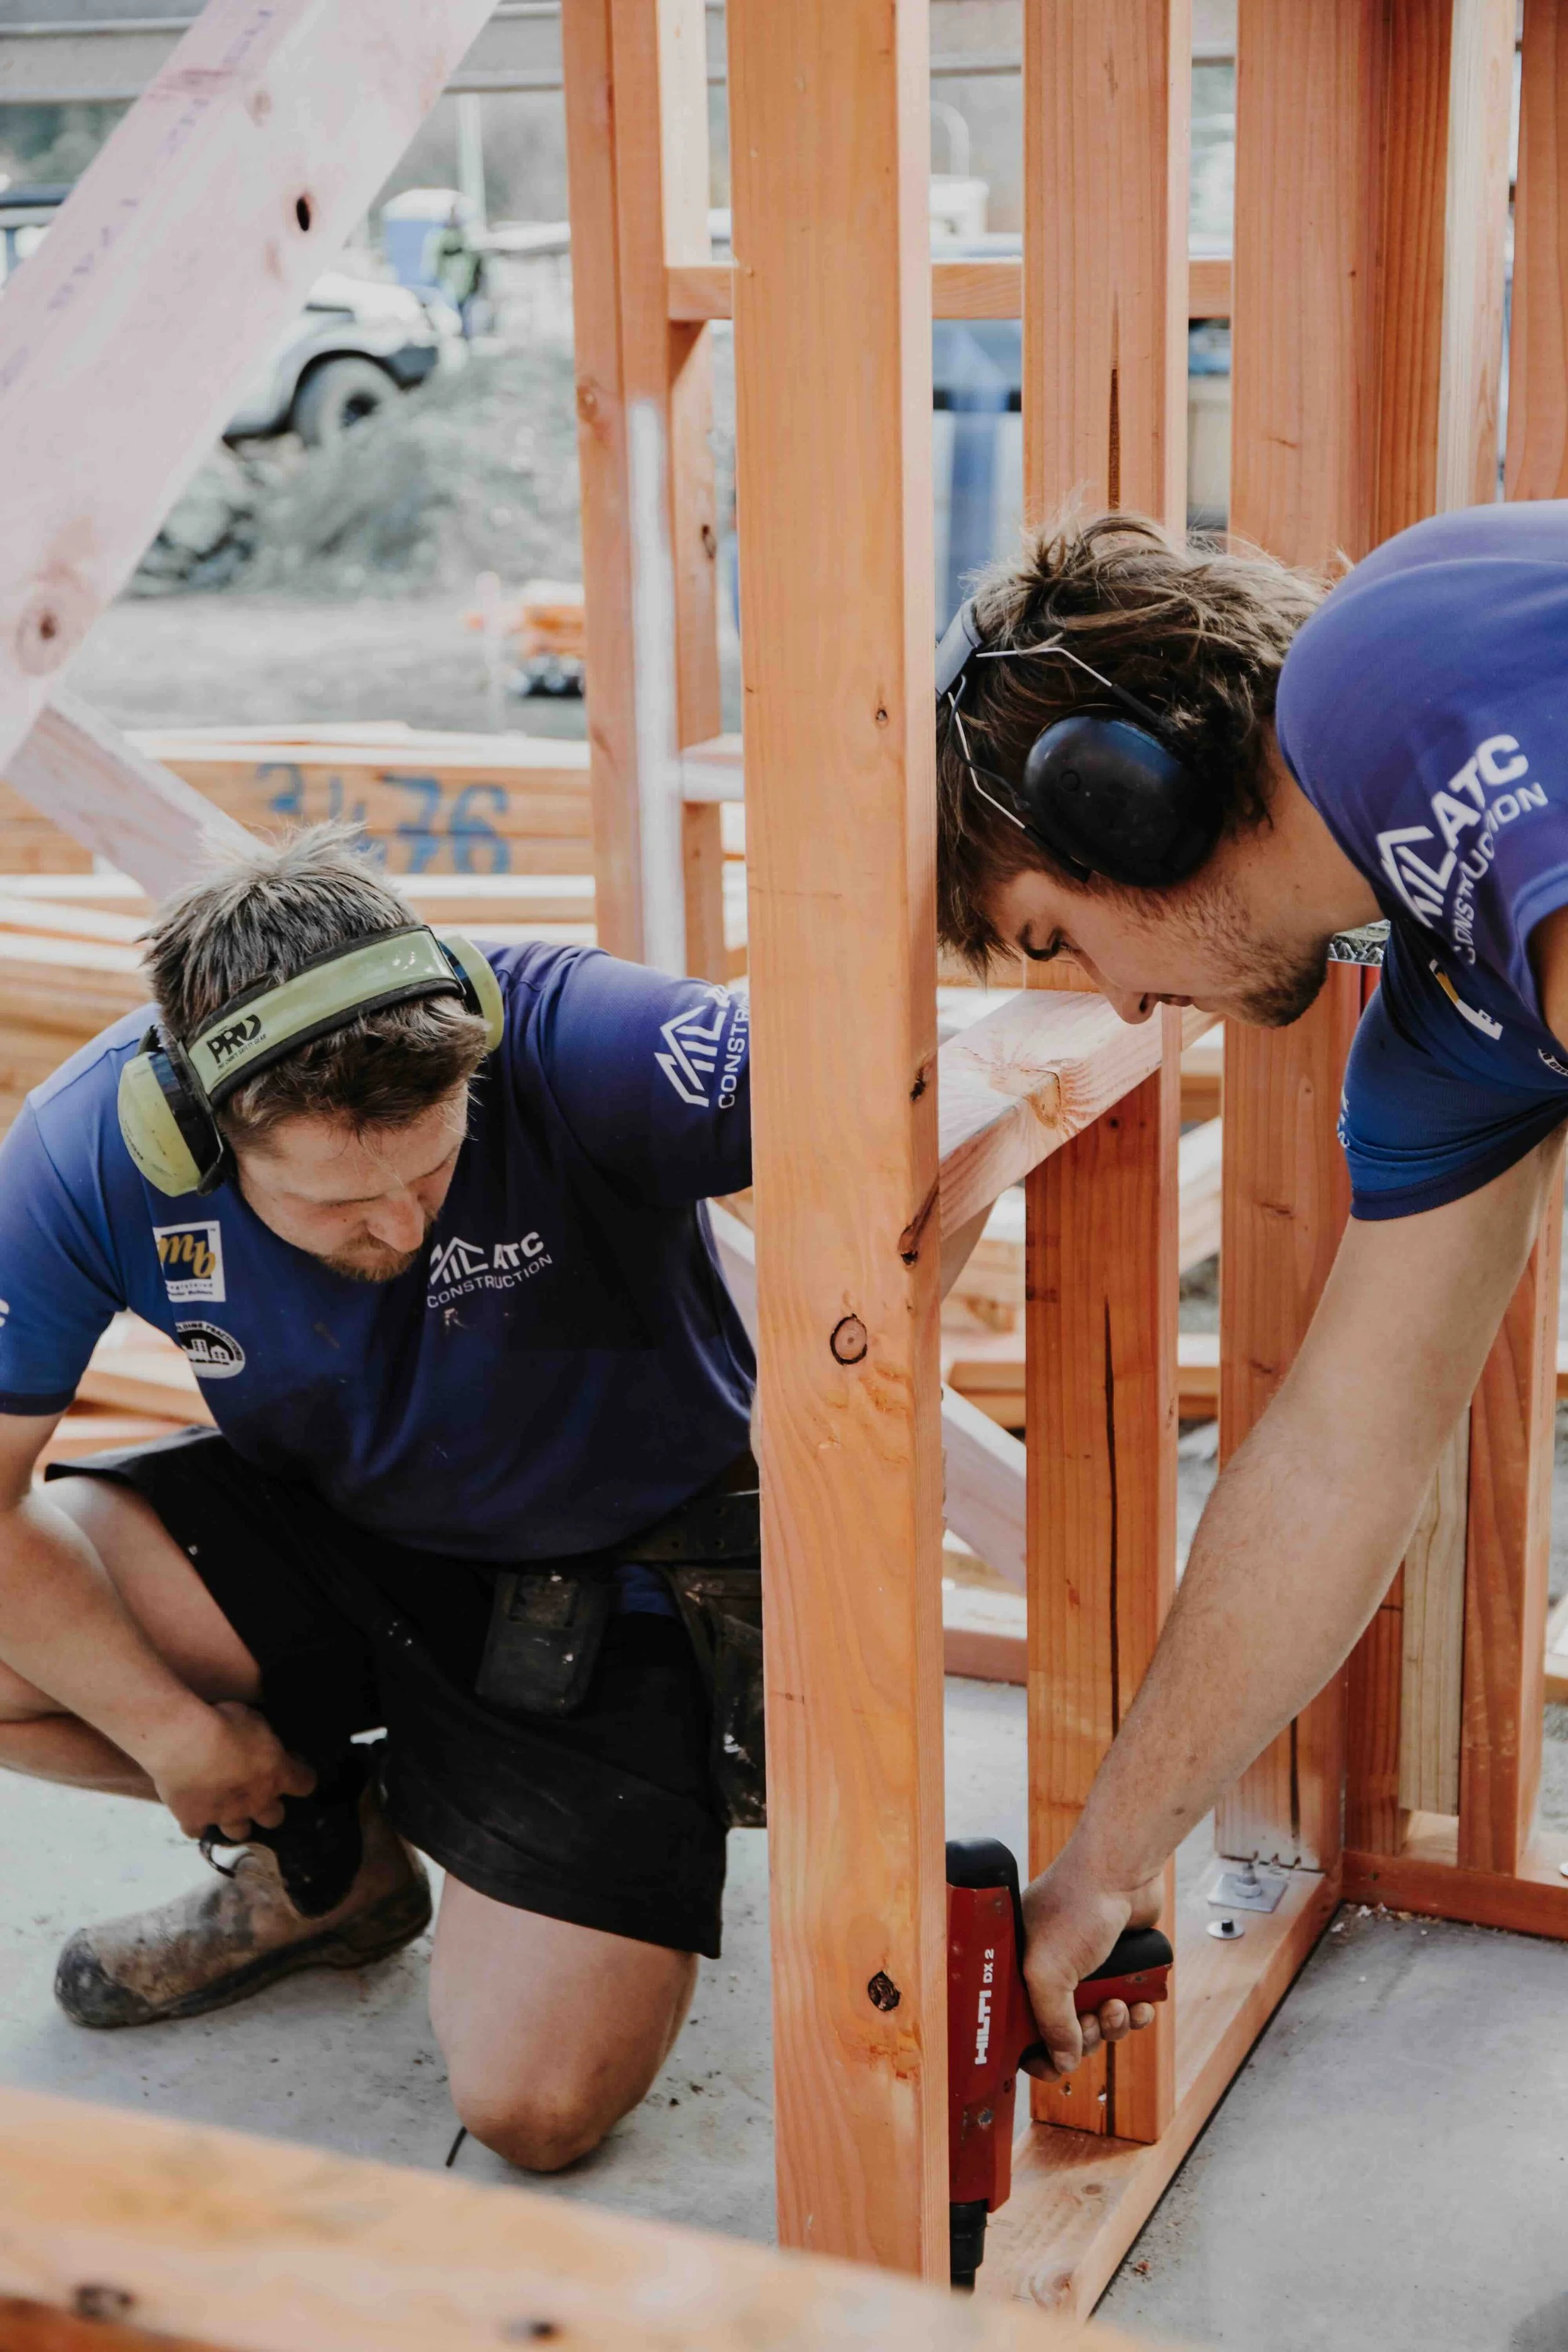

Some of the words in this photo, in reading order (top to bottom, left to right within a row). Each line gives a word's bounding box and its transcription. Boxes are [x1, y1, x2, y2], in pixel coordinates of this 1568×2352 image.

[1431, 734, 1529, 850] ATC
[206, 1014, 261, 1064] PRO
[493, 1231, 544, 1270] ATC
[426, 1254, 553, 1308] CONSTRUCTION
[983, 1963, 993, 1983] DX
[985, 1948, 994, 1959] 2
[975, 1990, 992, 2065] HILTI
